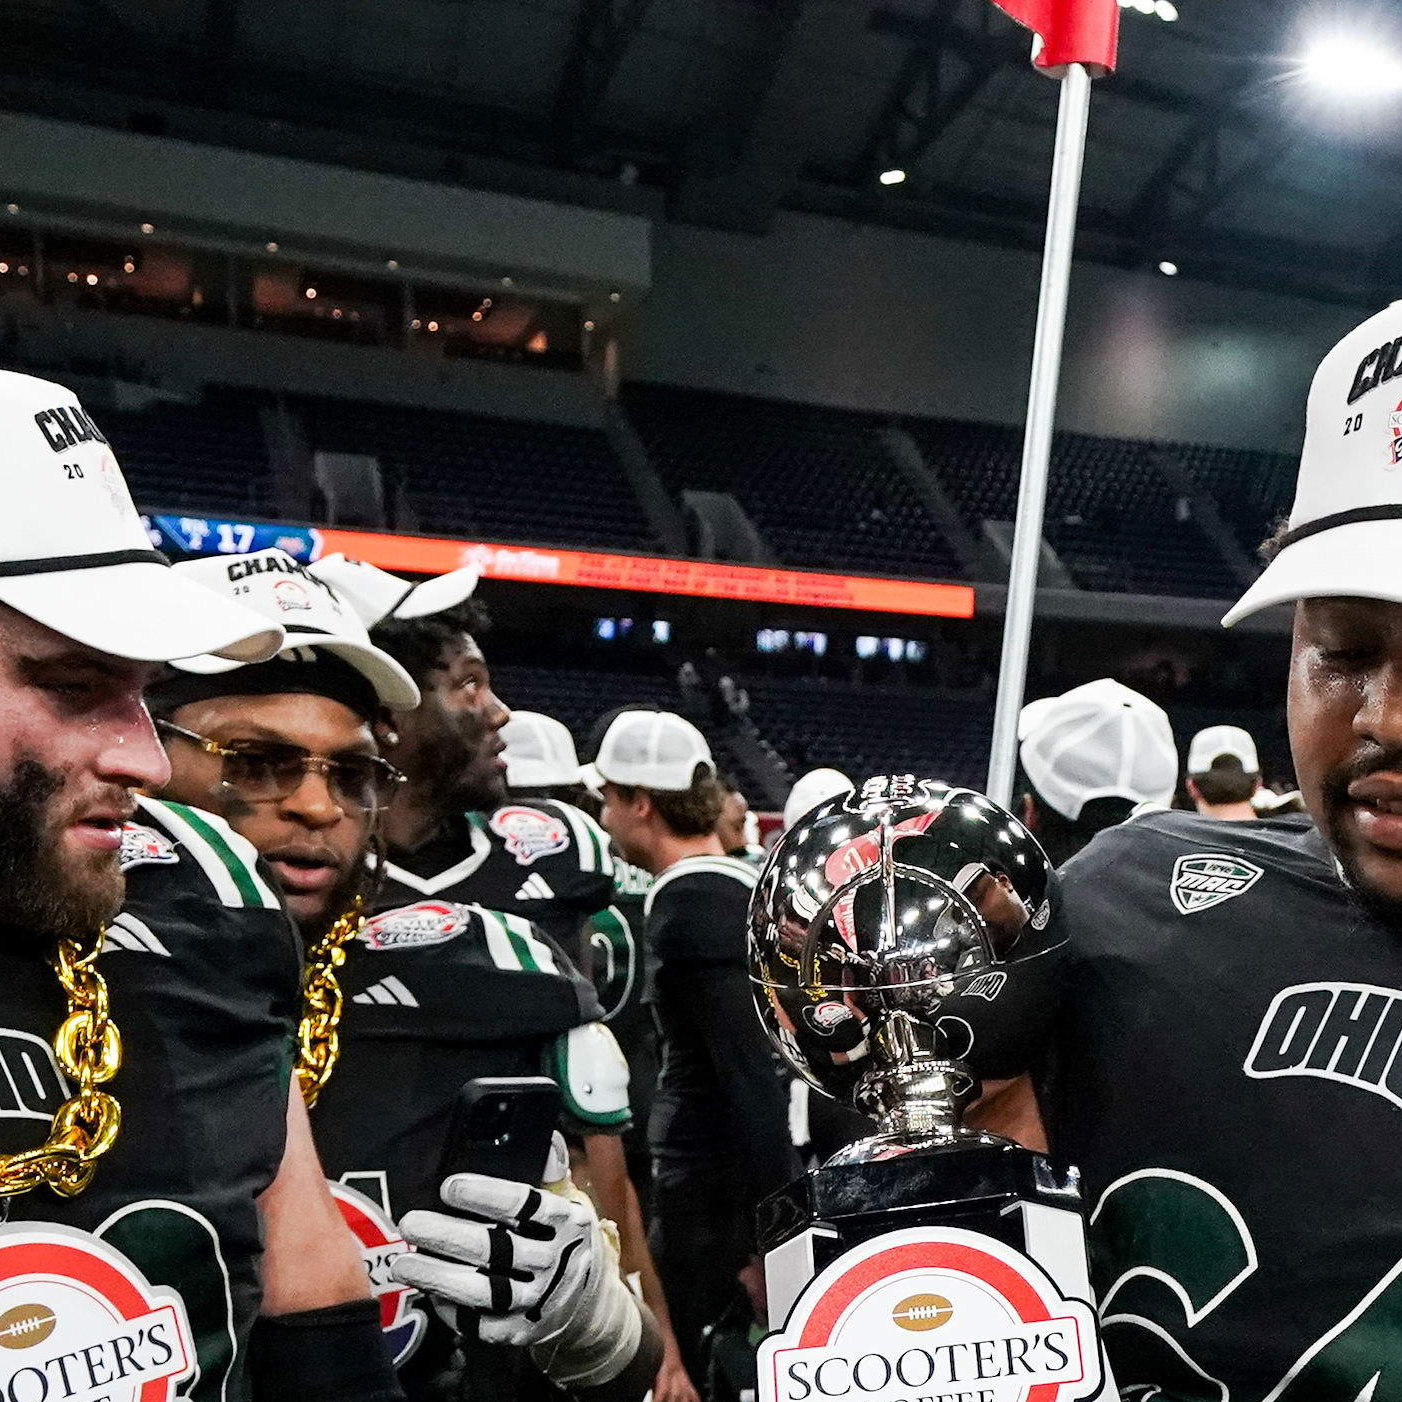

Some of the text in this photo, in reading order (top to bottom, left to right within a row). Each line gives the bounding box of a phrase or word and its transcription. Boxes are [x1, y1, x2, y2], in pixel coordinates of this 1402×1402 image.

[1342, 412, 1364, 437] 20
[63, 463, 85, 480] 20
[216, 523, 256, 554] 17
[1175, 871, 1249, 895] MAC
[787, 1331, 1071, 1402] SCOOTER'S
